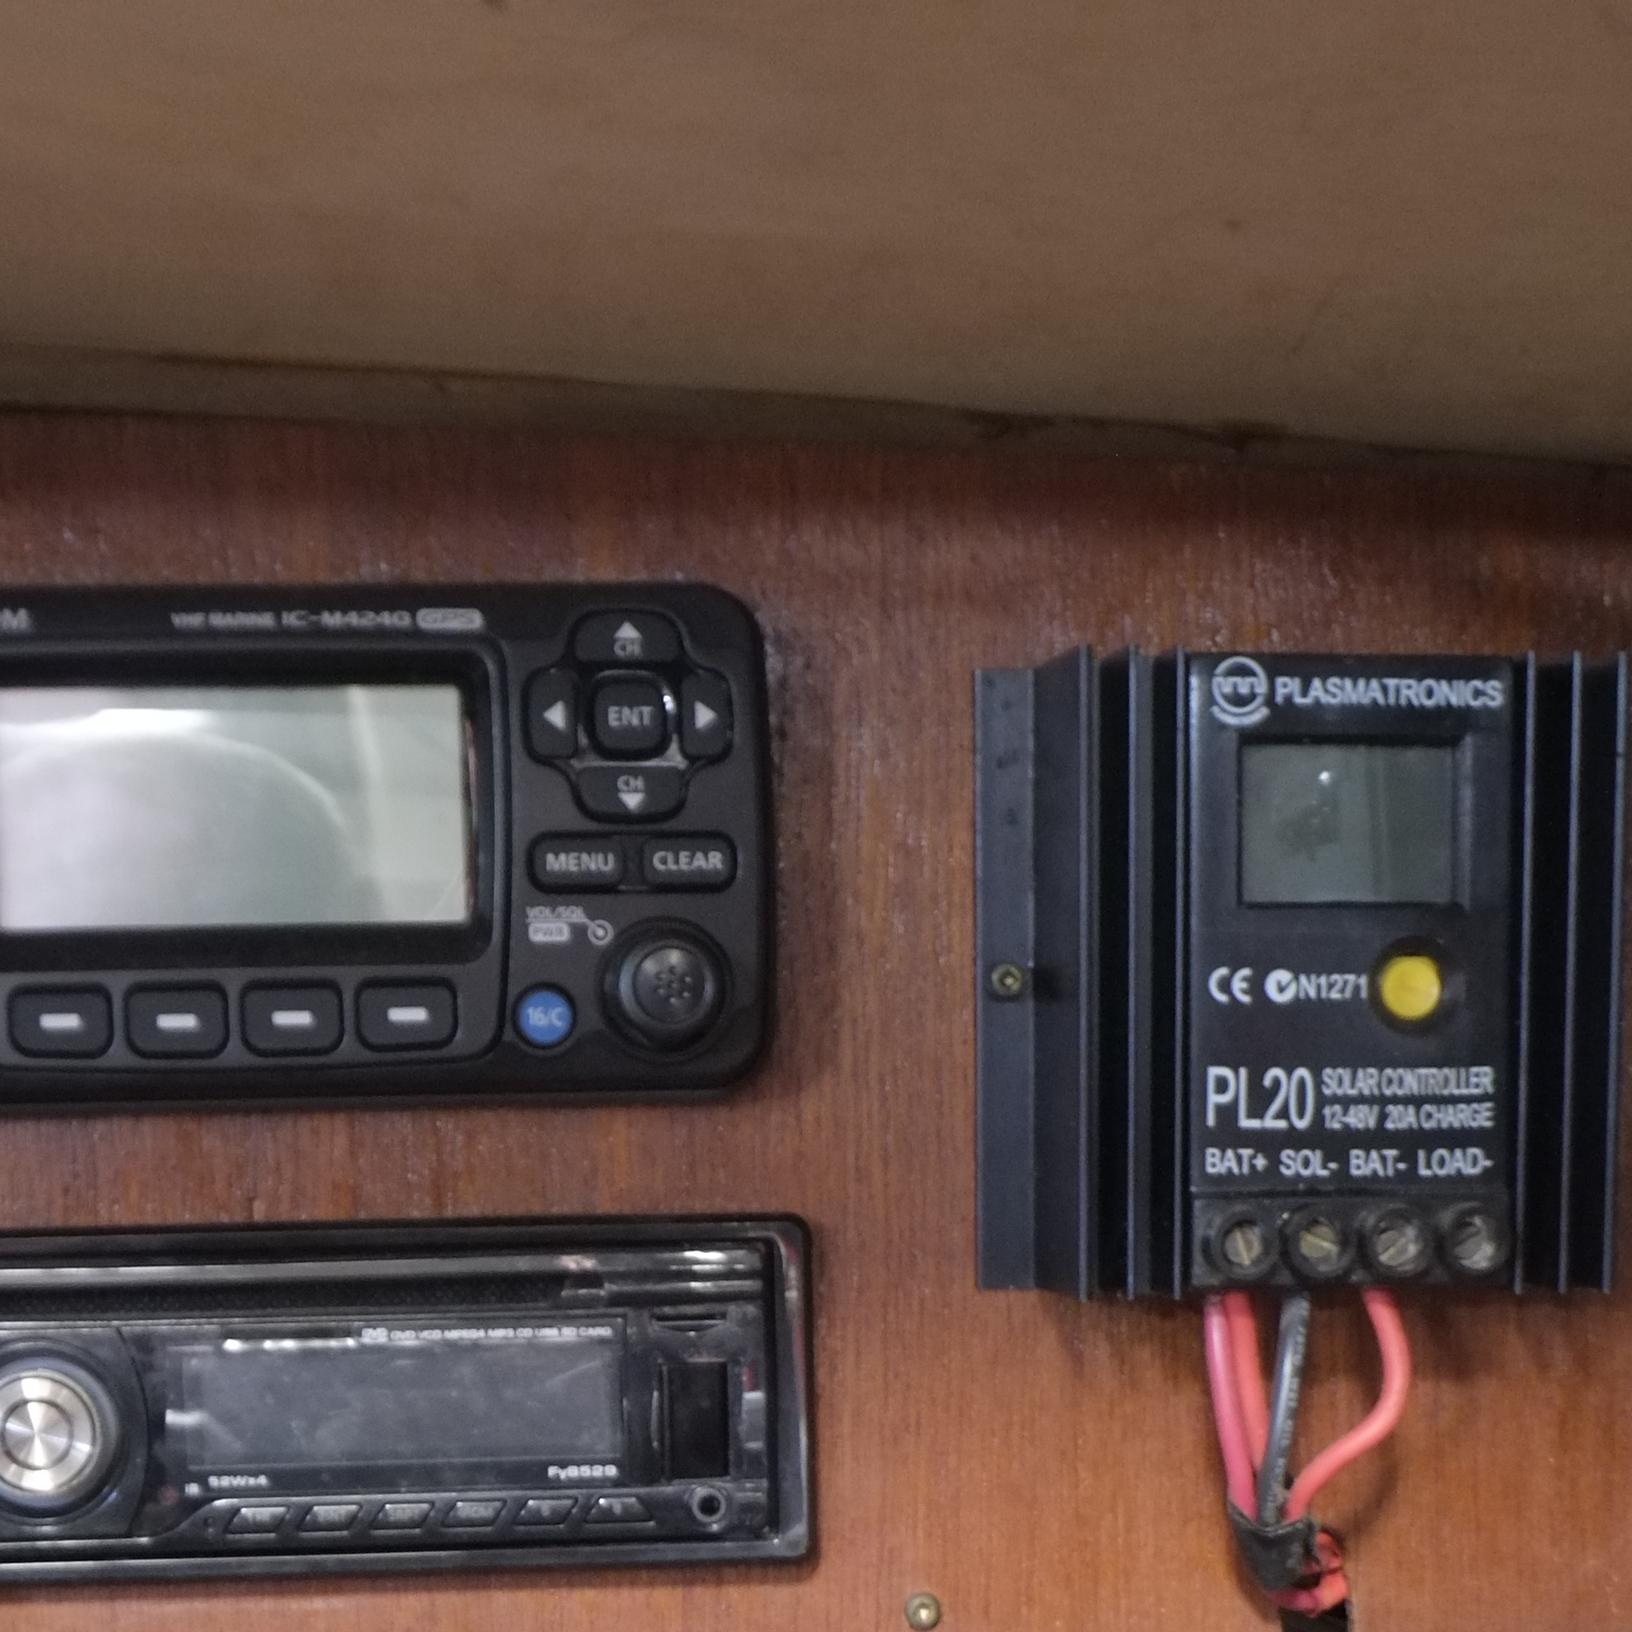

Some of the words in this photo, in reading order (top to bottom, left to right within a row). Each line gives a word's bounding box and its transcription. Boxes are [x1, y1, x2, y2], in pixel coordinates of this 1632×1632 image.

[613, 640, 644, 657] CH
[1274, 676, 1504, 708] PLASMATRONICS
[607, 705, 655, 727] ENT
[617, 775, 645, 792] CH
[545, 852, 616, 872] MENU
[652, 851, 723, 871] CLEAR
[1207, 966, 1254, 1005] CE
[1298, 973, 1369, 1001] N1271
[527, 1007, 565, 1027] 16/C
[1320, 1066, 1380, 1096] SOLAR
[1380, 1066, 1495, 1096] CONTROLLER
[1205, 1065, 1315, 1131] PL20
[1321, 1104, 1380, 1130] 12-48V
[1384, 1104, 1418, 1130] 20A
[1418, 1102, 1495, 1130] CHARGE
[1204, 1147, 1268, 1176] BAT+
[1278, 1149, 1340, 1177] SOL-
[1348, 1149, 1409, 1178] BAT-
[1418, 1147, 1495, 1178] LOAD-
[578, 1325, 613, 1337] CARD
